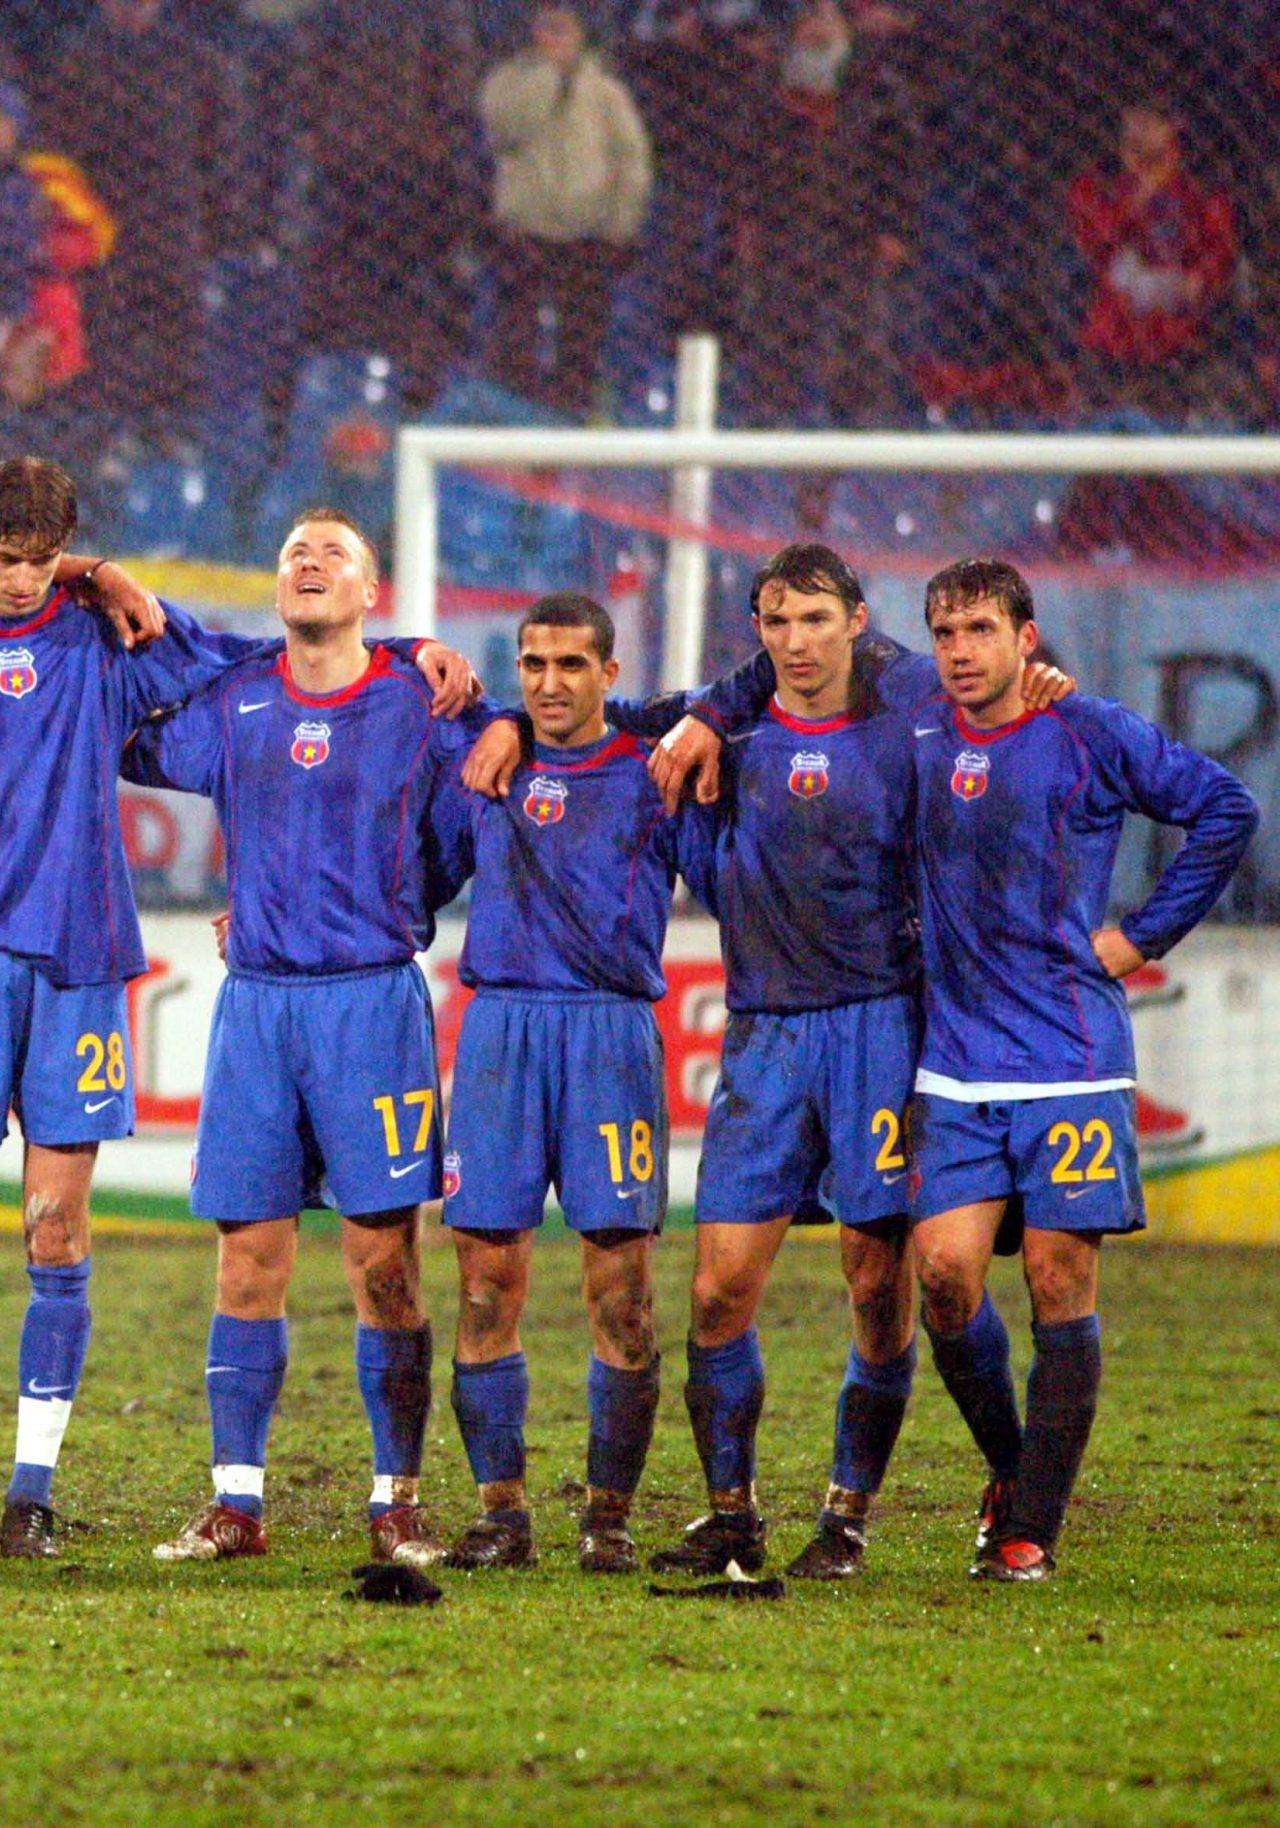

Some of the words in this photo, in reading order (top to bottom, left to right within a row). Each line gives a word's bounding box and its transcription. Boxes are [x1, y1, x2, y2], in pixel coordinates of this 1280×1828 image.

[77, 1033, 126, 1091] 28
[374, 1089, 435, 1157] 17
[600, 1119, 655, 1183] 18
[871, 1107, 912, 1172] 2
[1047, 1119, 1116, 1185] 22
